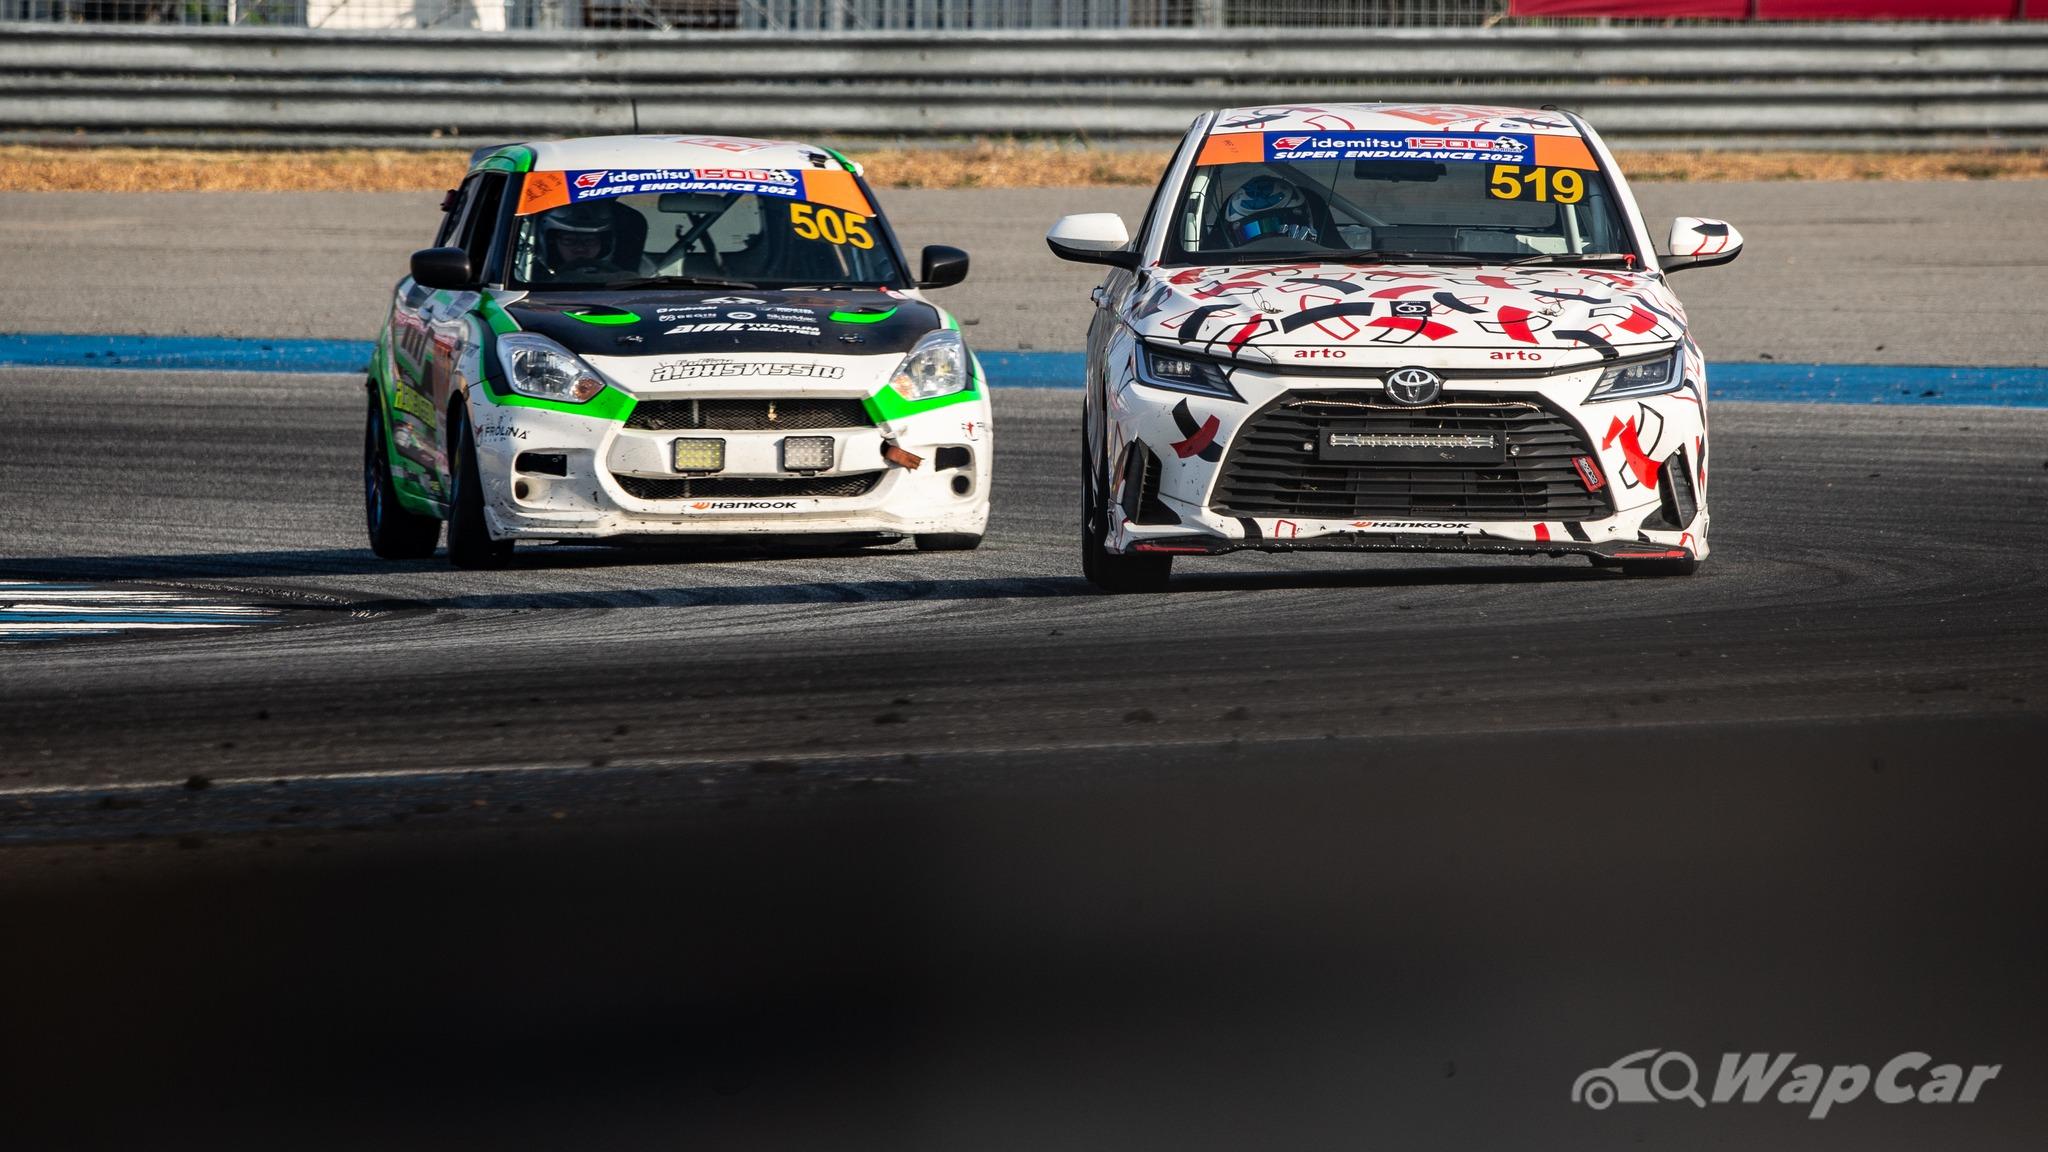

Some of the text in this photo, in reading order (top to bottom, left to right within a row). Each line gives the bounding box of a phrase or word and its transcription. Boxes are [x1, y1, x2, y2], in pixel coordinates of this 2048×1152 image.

[1312, 136, 1403, 149] idemitsu
[1273, 150, 1524, 163] SUPER ENDURANCE 2022
[608, 169, 690, 183] idemitsu
[577, 184, 634, 199] SUPER
[639, 182, 756, 192] ENDURANCE
[758, 184, 798, 197] 2022
[1490, 165, 1585, 205] 519
[789, 203, 875, 250] 505
[1293, 348, 1347, 360] arto
[1488, 350, 1543, 361] arto
